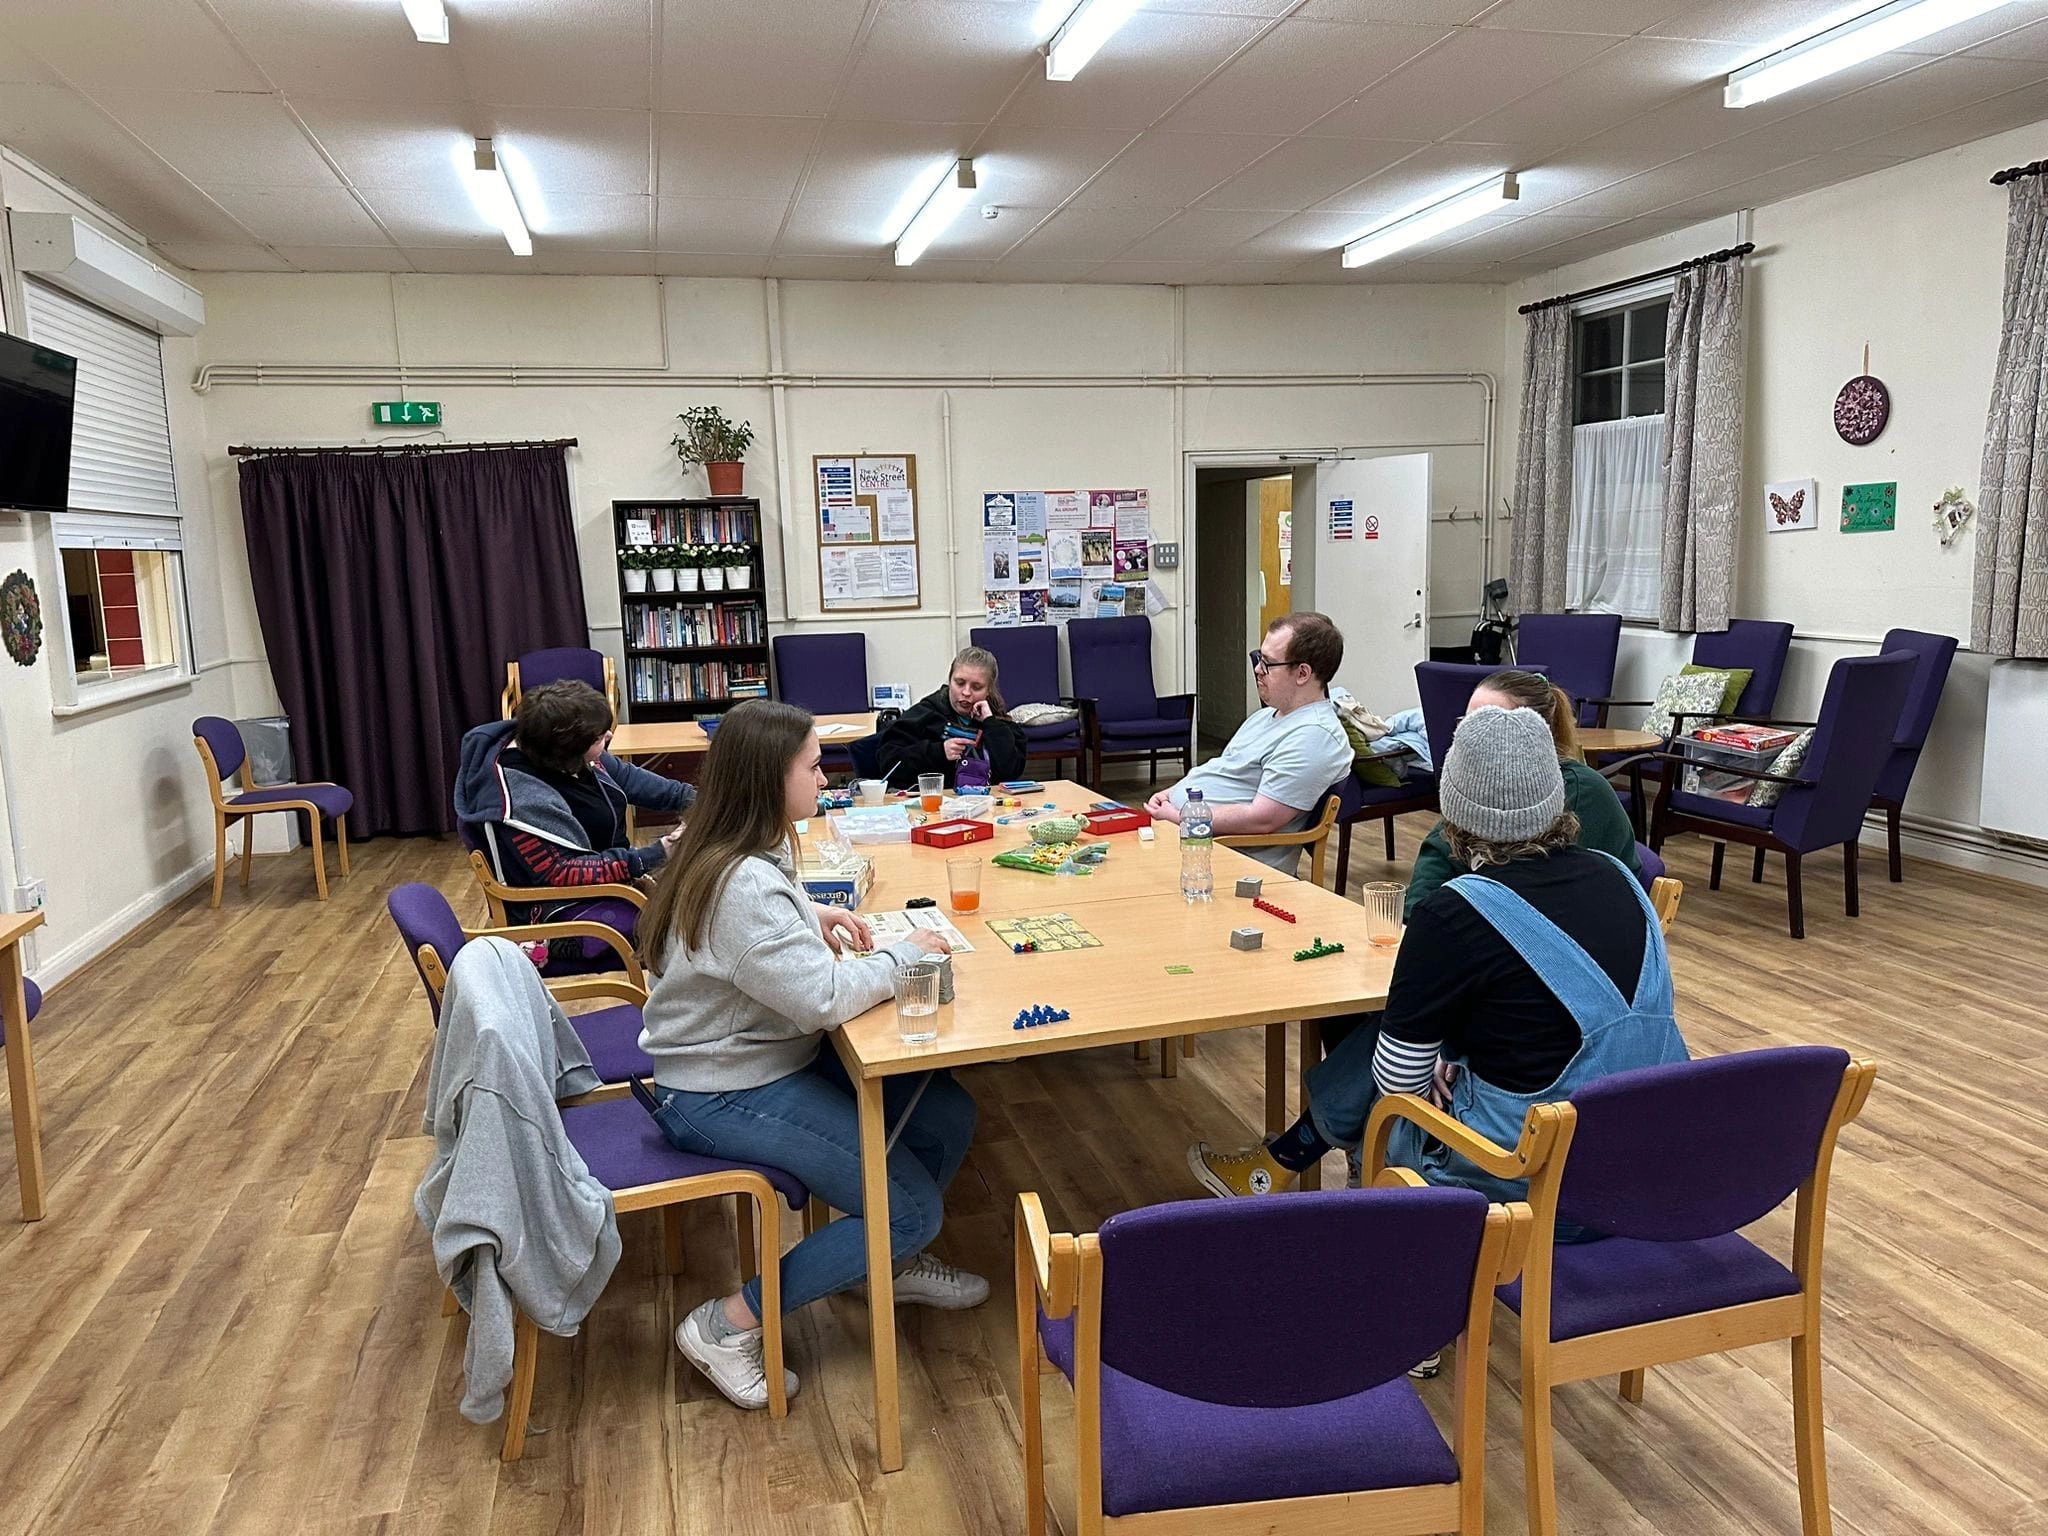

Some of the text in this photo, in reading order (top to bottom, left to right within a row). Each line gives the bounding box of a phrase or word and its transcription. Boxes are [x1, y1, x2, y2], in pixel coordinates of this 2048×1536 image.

[859, 472, 906, 482] New Street
[860, 480, 890, 488] CENTRE
